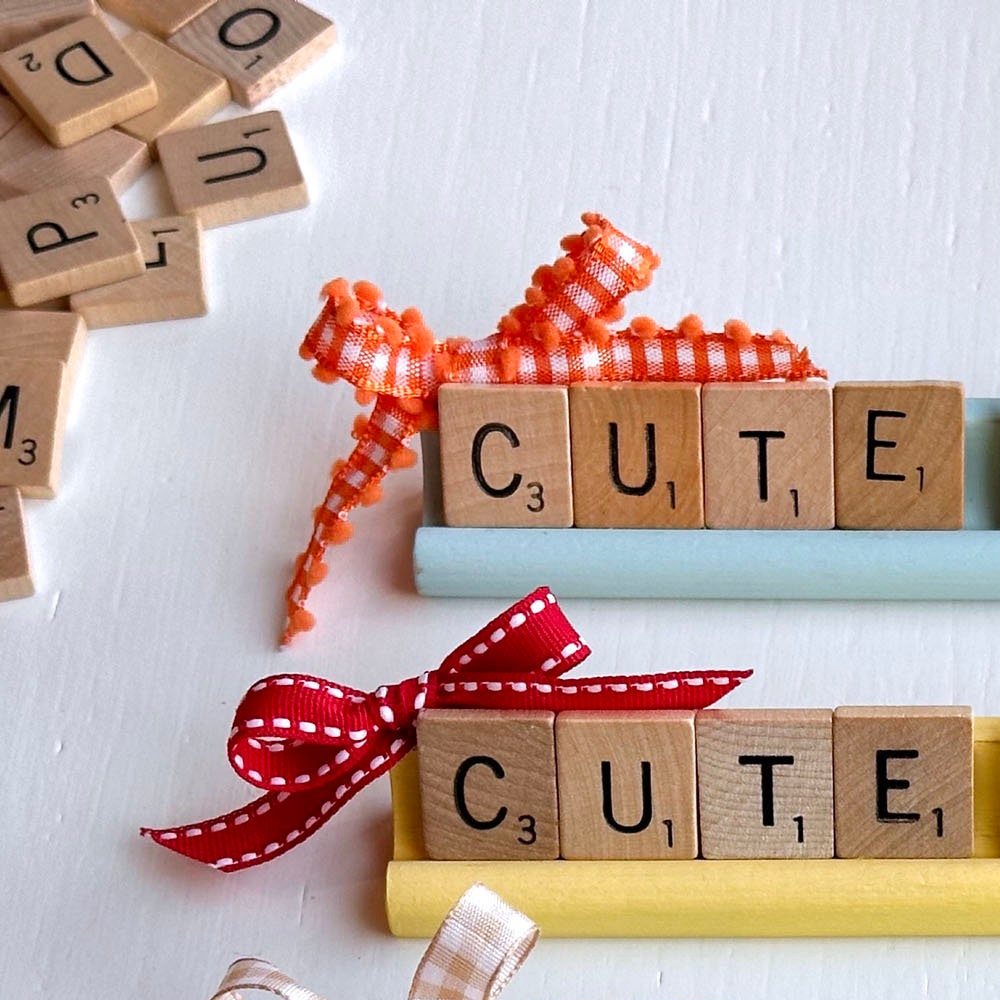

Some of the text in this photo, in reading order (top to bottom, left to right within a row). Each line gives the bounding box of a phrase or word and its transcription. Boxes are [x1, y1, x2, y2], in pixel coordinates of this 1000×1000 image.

[217, 7, 282, 51] O
[18, 52, 42, 73] 2
[54, 40, 115, 87] D
[242, 127, 271, 139] 1
[197, 145, 268, 185] U
[71, 192, 101, 210] 3
[26, 220, 99, 255] P
[152, 228, 180, 238] 1
[17, 438, 38, 466] 3
[525, 481, 546, 514] 3
[665, 479, 677, 511] 1
[788, 487, 800, 519] 1
[913, 464, 926, 494] 1
[516, 813, 538, 847] 3
[660, 818, 674, 849] 1
[791, 814, 805, 845] 1
[930, 806, 945, 839] 1
